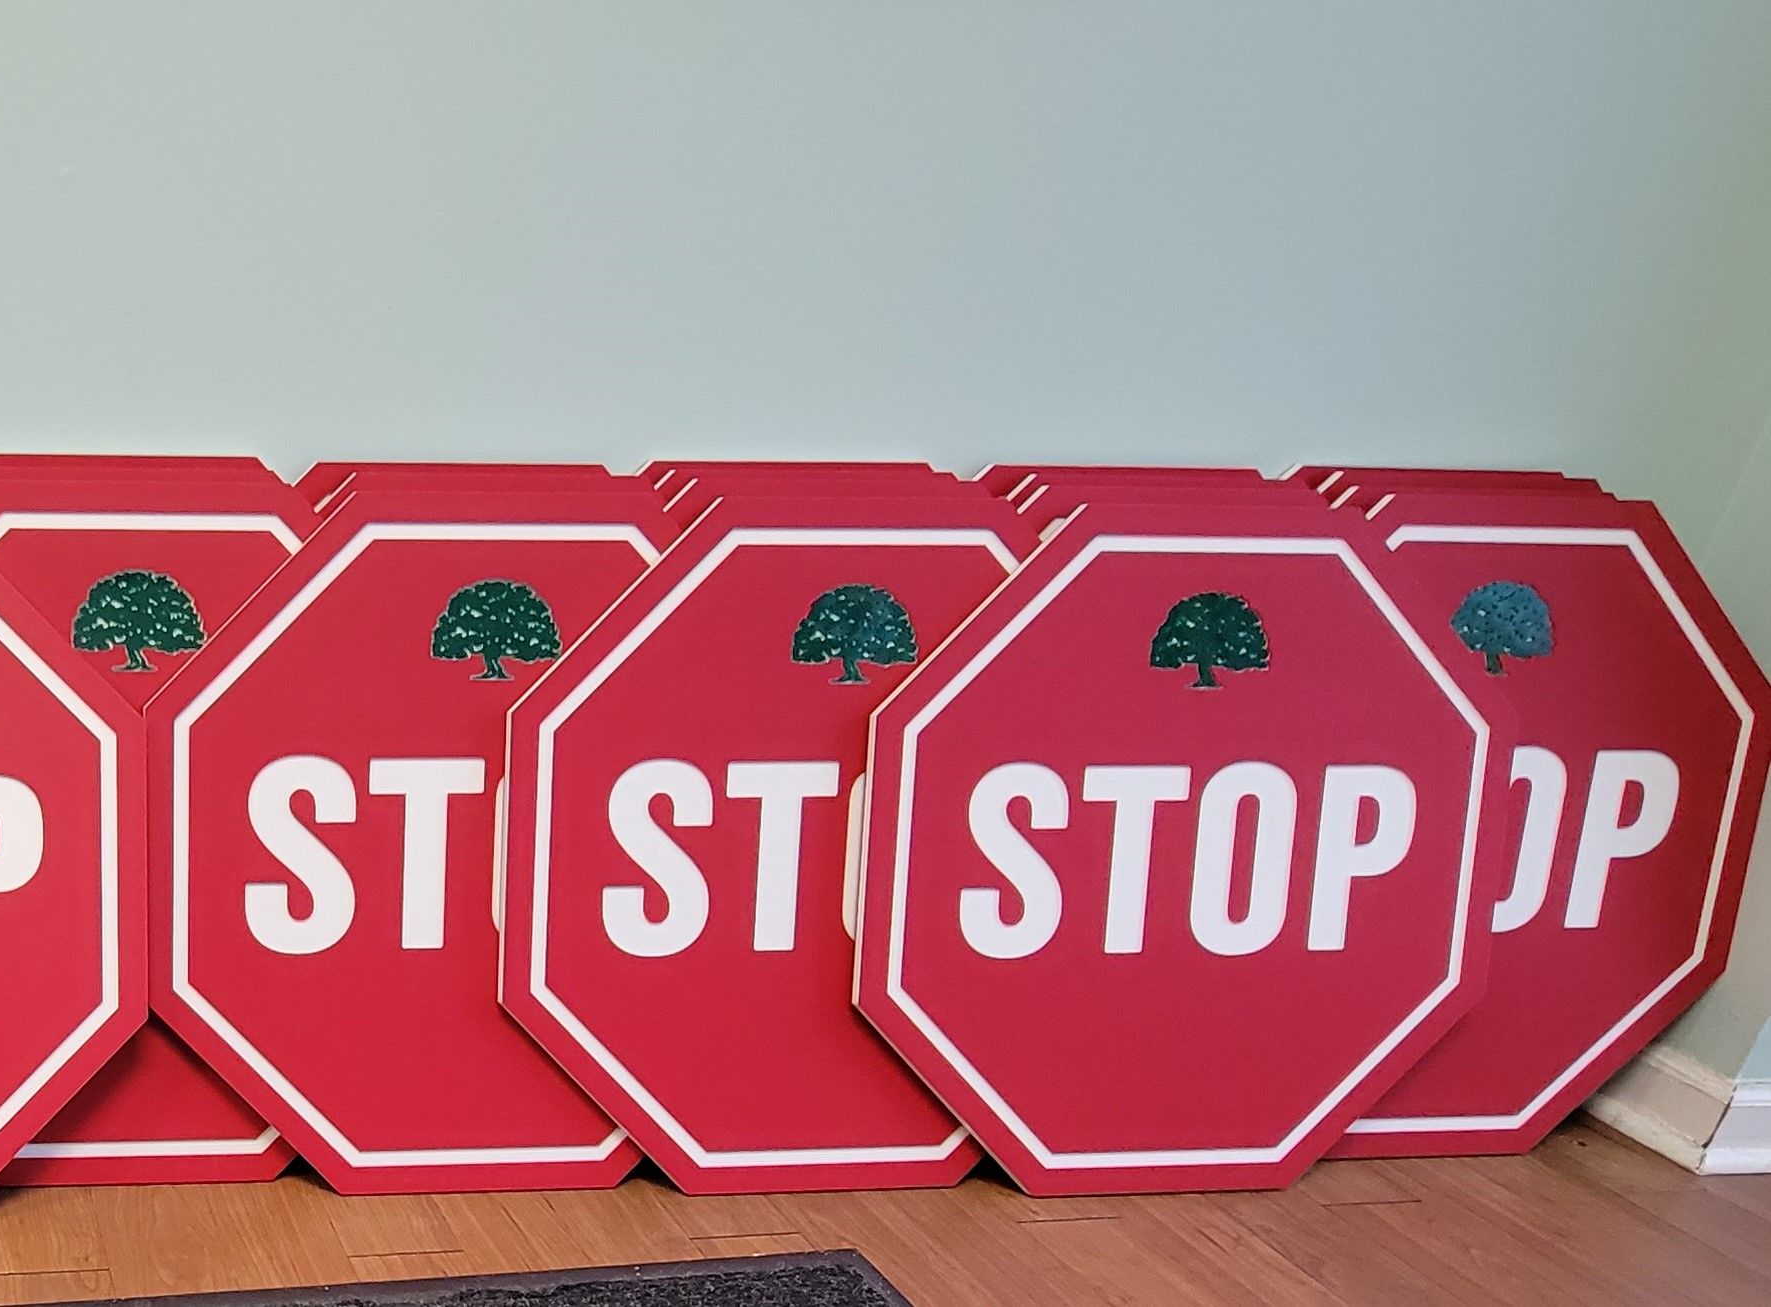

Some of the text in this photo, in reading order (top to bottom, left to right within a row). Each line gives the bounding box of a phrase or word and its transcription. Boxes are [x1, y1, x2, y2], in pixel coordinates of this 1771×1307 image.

[244, 755, 505, 955] ST
[602, 759, 866, 958] ST
[959, 761, 1417, 959] STOP
